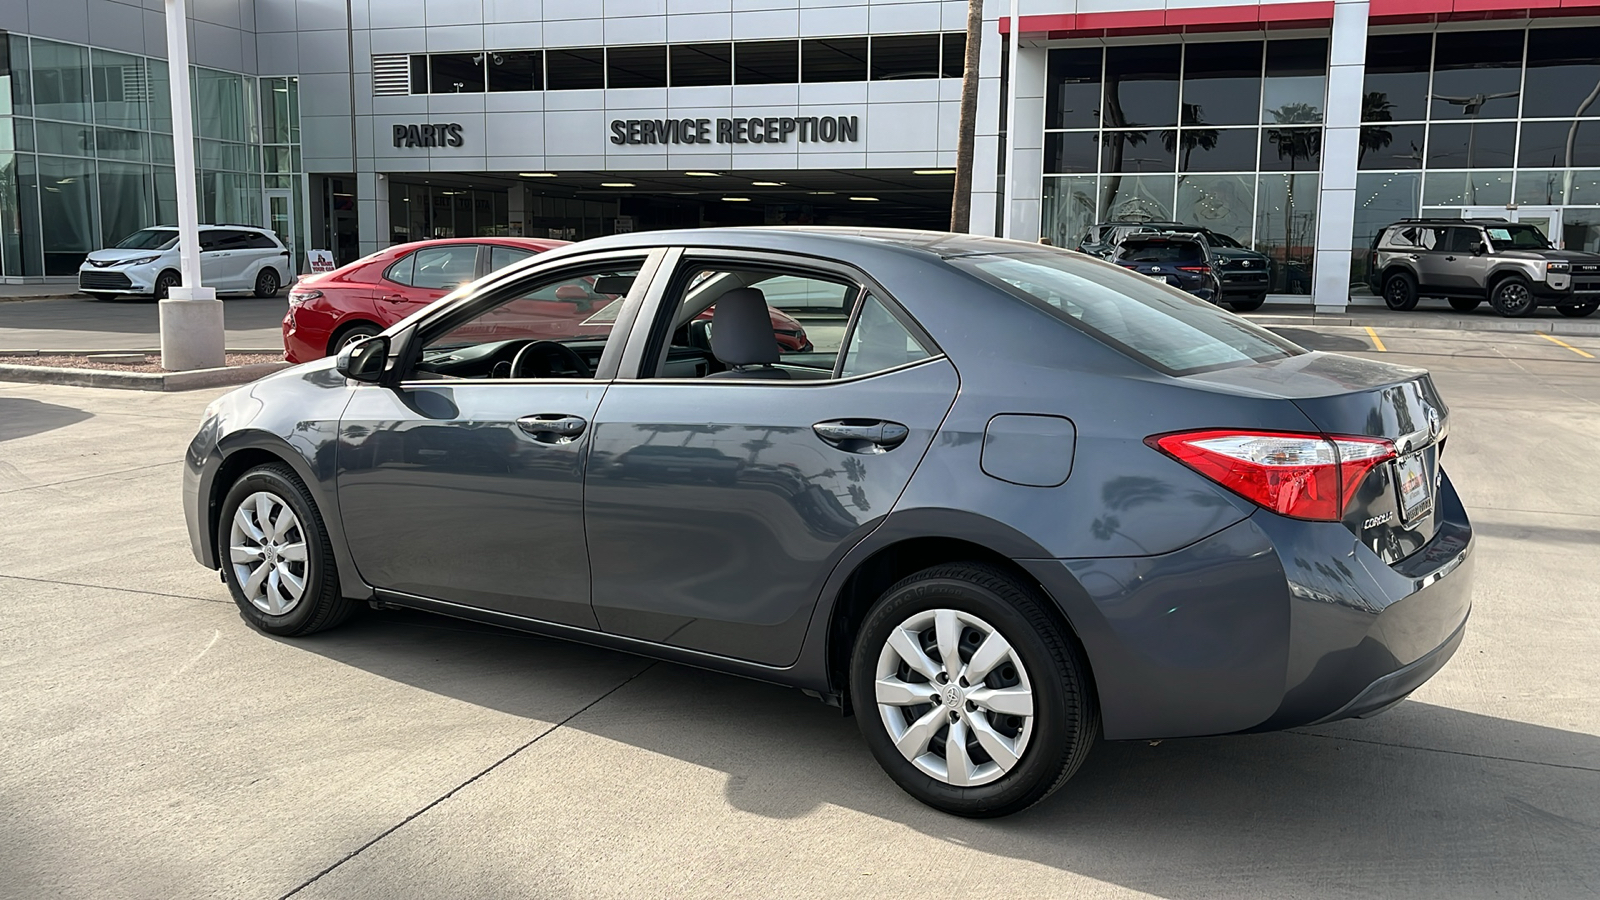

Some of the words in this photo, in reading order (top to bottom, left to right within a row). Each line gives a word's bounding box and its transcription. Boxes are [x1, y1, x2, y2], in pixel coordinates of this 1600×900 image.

[392, 123, 464, 147] PARTS
[610, 118, 711, 145] SERVICE
[716, 115, 858, 143] RECEPTION
[417, 195, 450, 206] DEERT
[459, 198, 490, 209] TOOTA
[1364, 511, 1393, 529] COROLLA
